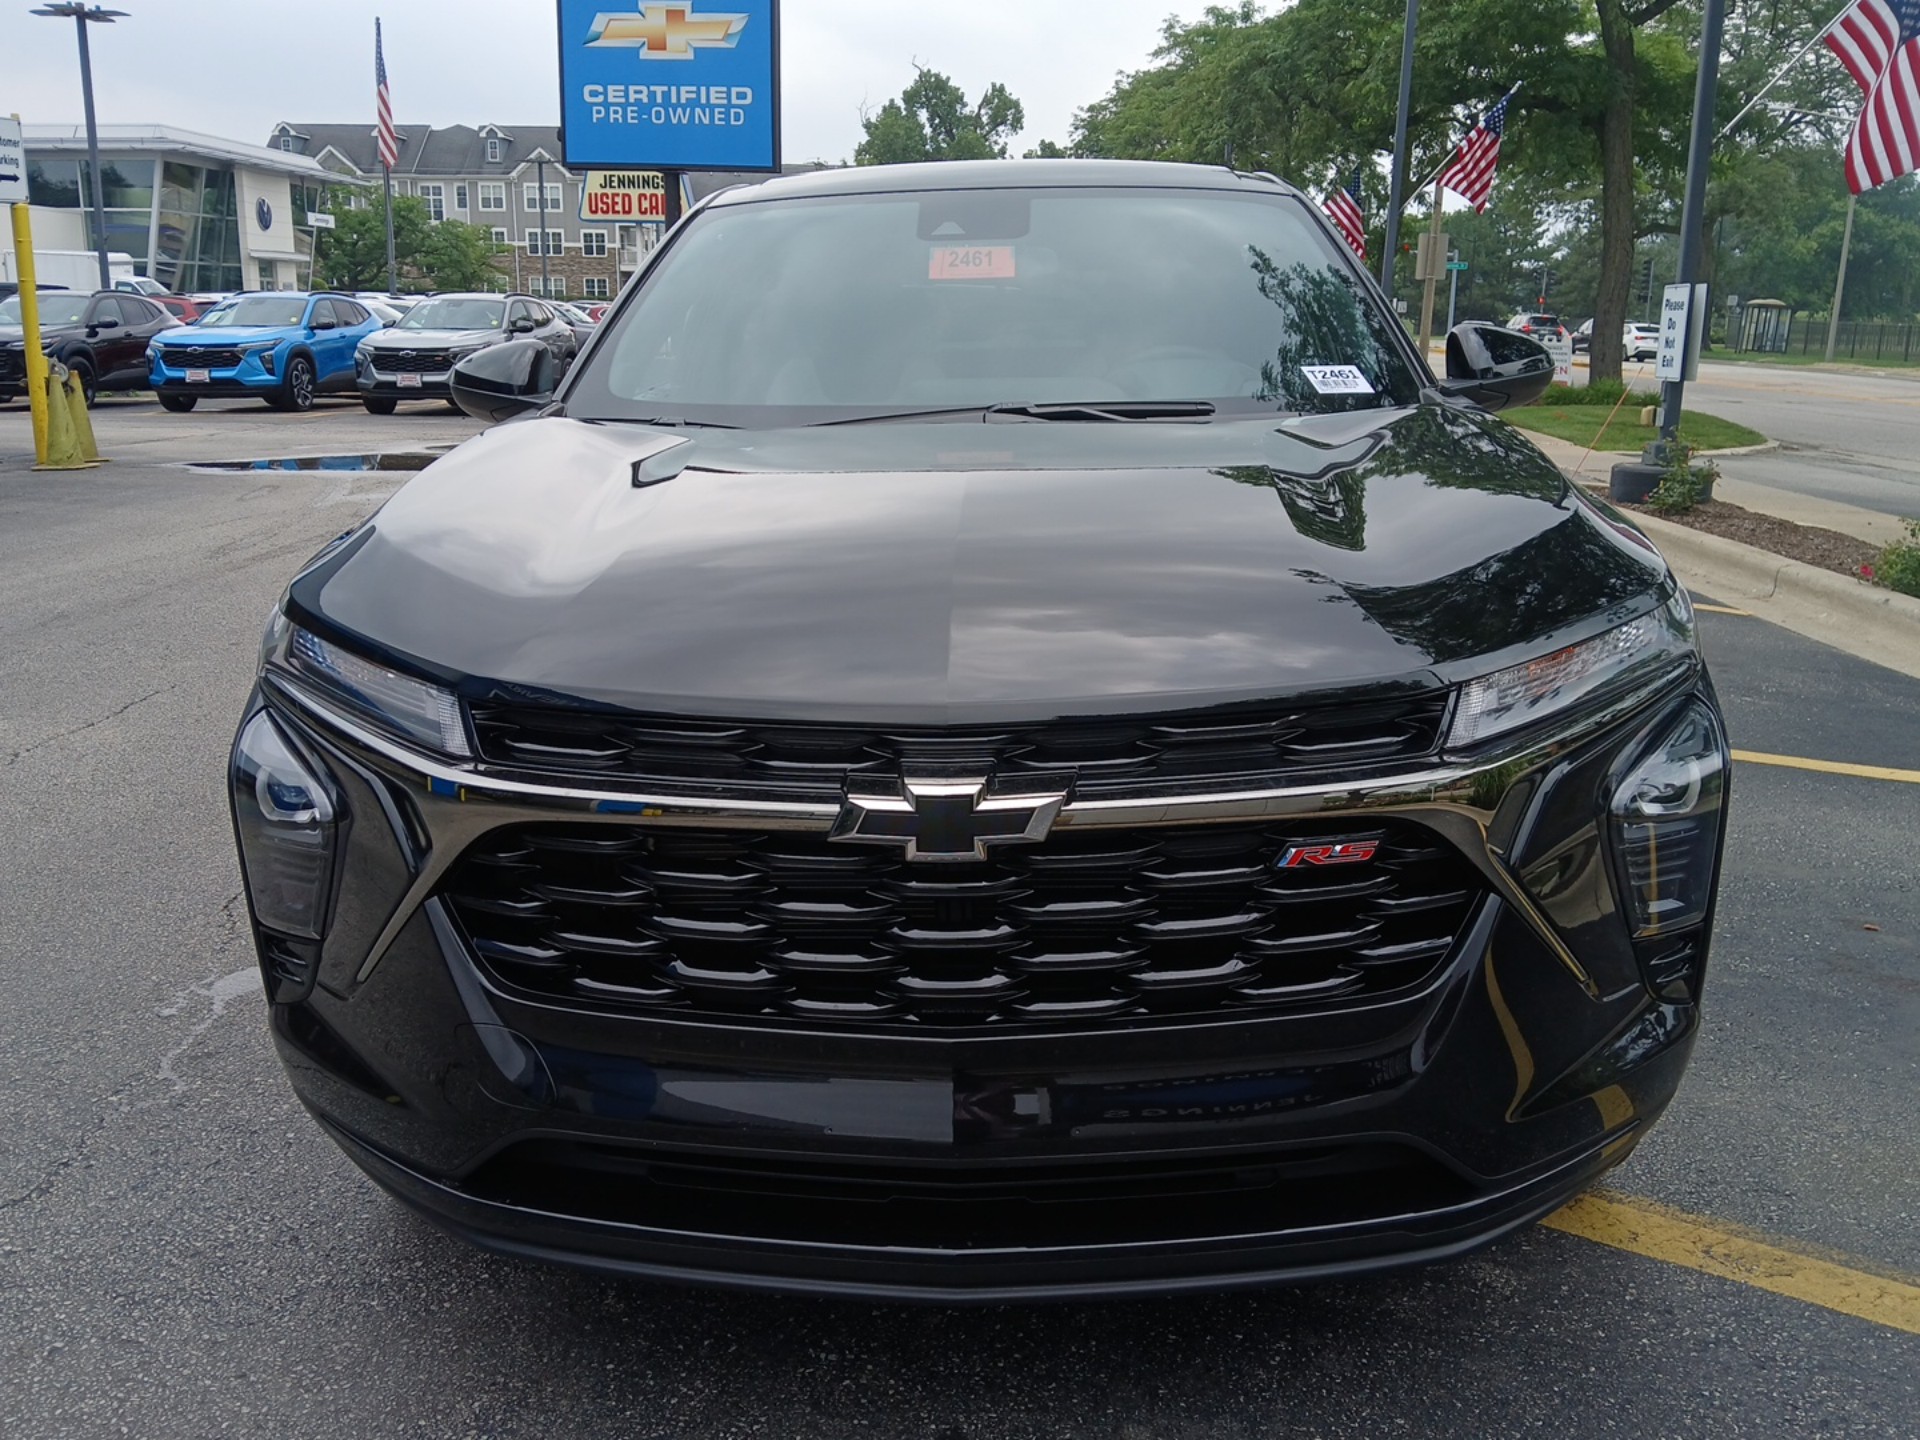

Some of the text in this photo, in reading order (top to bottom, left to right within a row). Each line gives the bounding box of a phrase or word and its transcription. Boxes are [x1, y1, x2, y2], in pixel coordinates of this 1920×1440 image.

[583, 85, 753, 104] CERTIFIED
[592, 106, 745, 125] PRE-OWNED
[588, 193, 632, 215] USED
[948, 250, 993, 268] 2461
[1664, 299, 1685, 311] Please
[1667, 317, 1677, 330] Do
[1664, 336, 1676, 349] Not
[1662, 355, 1674, 368] Exit
[1307, 370, 1360, 380] T2461
[1277, 841, 1379, 867] RS
